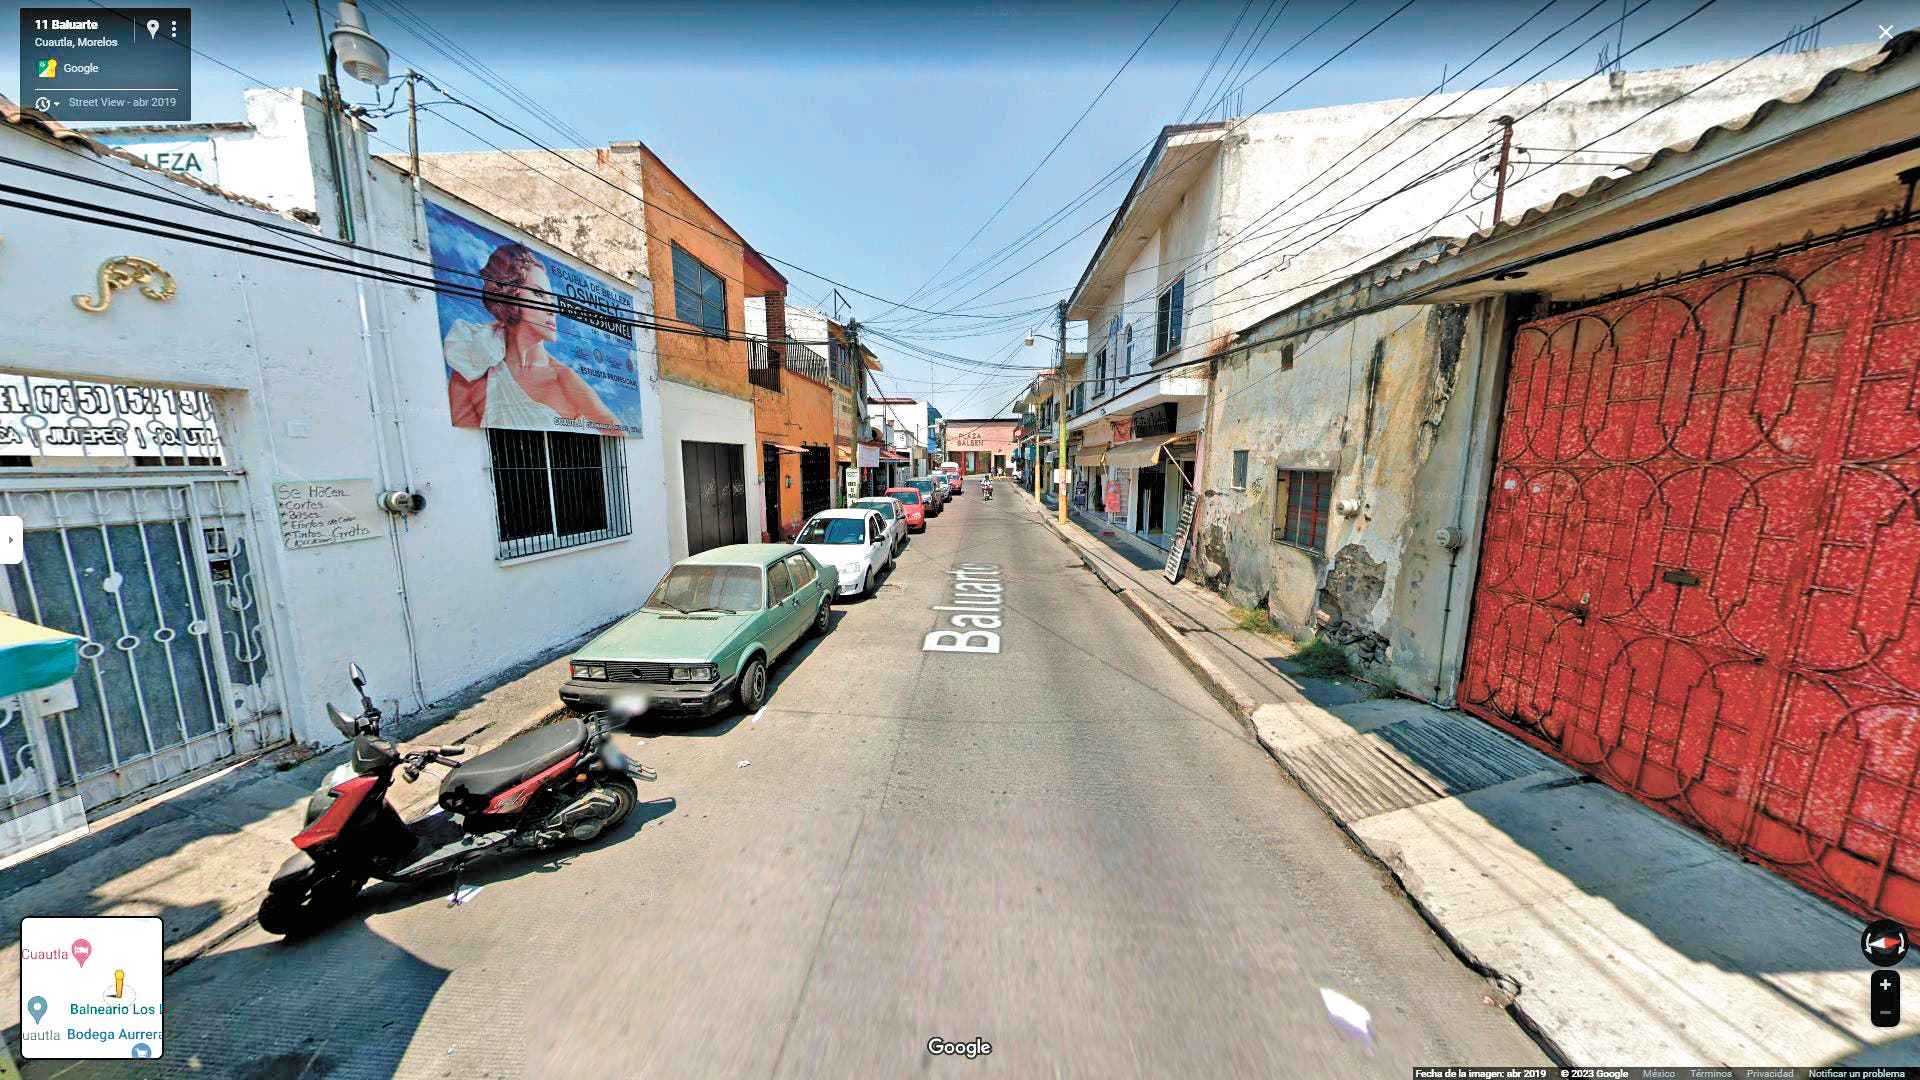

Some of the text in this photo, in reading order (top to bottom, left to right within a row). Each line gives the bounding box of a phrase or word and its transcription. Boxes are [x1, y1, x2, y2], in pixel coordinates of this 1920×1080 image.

[551, 265, 632, 308] ESCUELA DE BELLEZA
[279, 484, 350, 500] Se Hacen
[285, 499, 324, 510] Cortes
